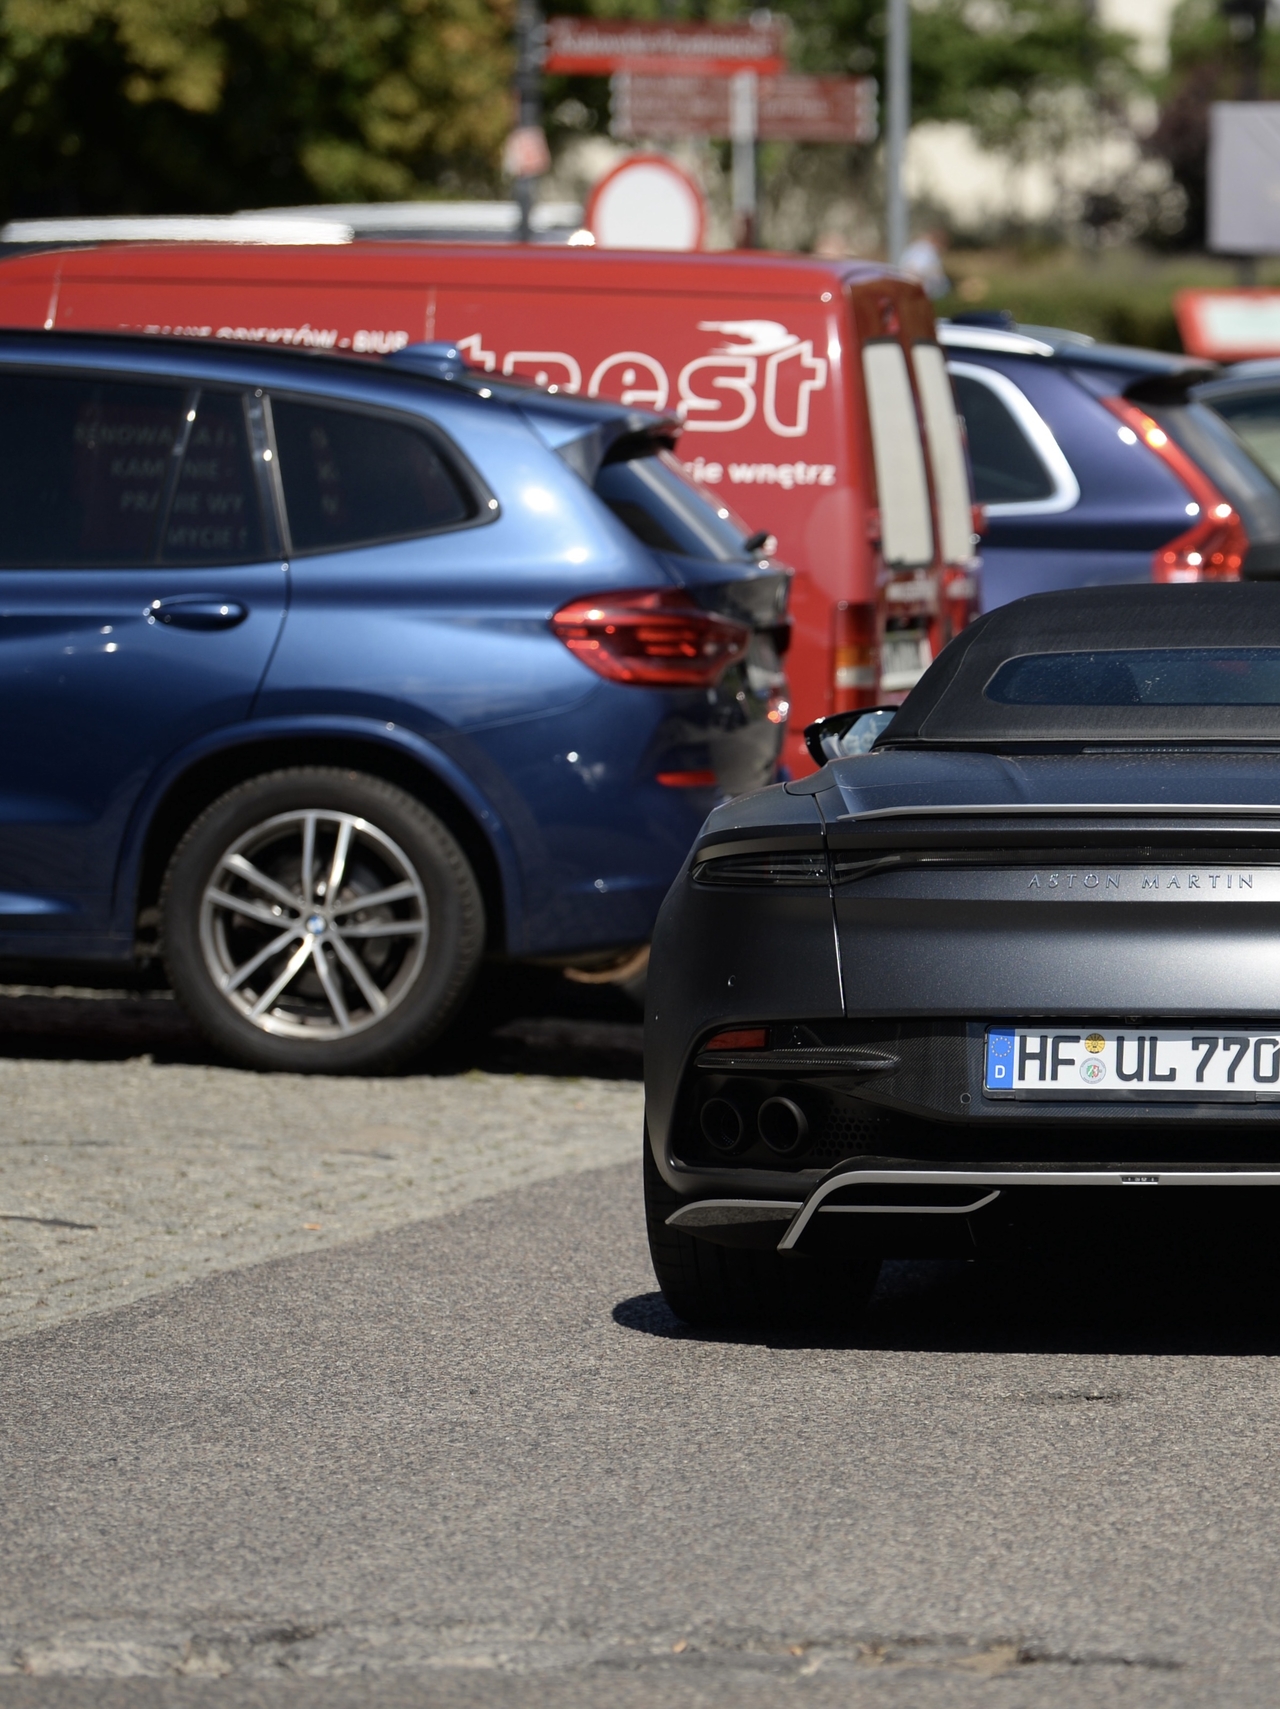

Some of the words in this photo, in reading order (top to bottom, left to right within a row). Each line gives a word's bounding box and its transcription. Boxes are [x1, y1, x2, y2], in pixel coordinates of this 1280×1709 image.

[456, 333, 827, 437] rest
[727, 461, 837, 490] wnętrz
[1028, 873, 1121, 889] ASTON
[1141, 873, 1254, 889] MARTIN
[994, 1064, 1006, 1079] D
[1017, 1035, 1081, 1081] HF
[1116, 1036, 1177, 1082] UL
